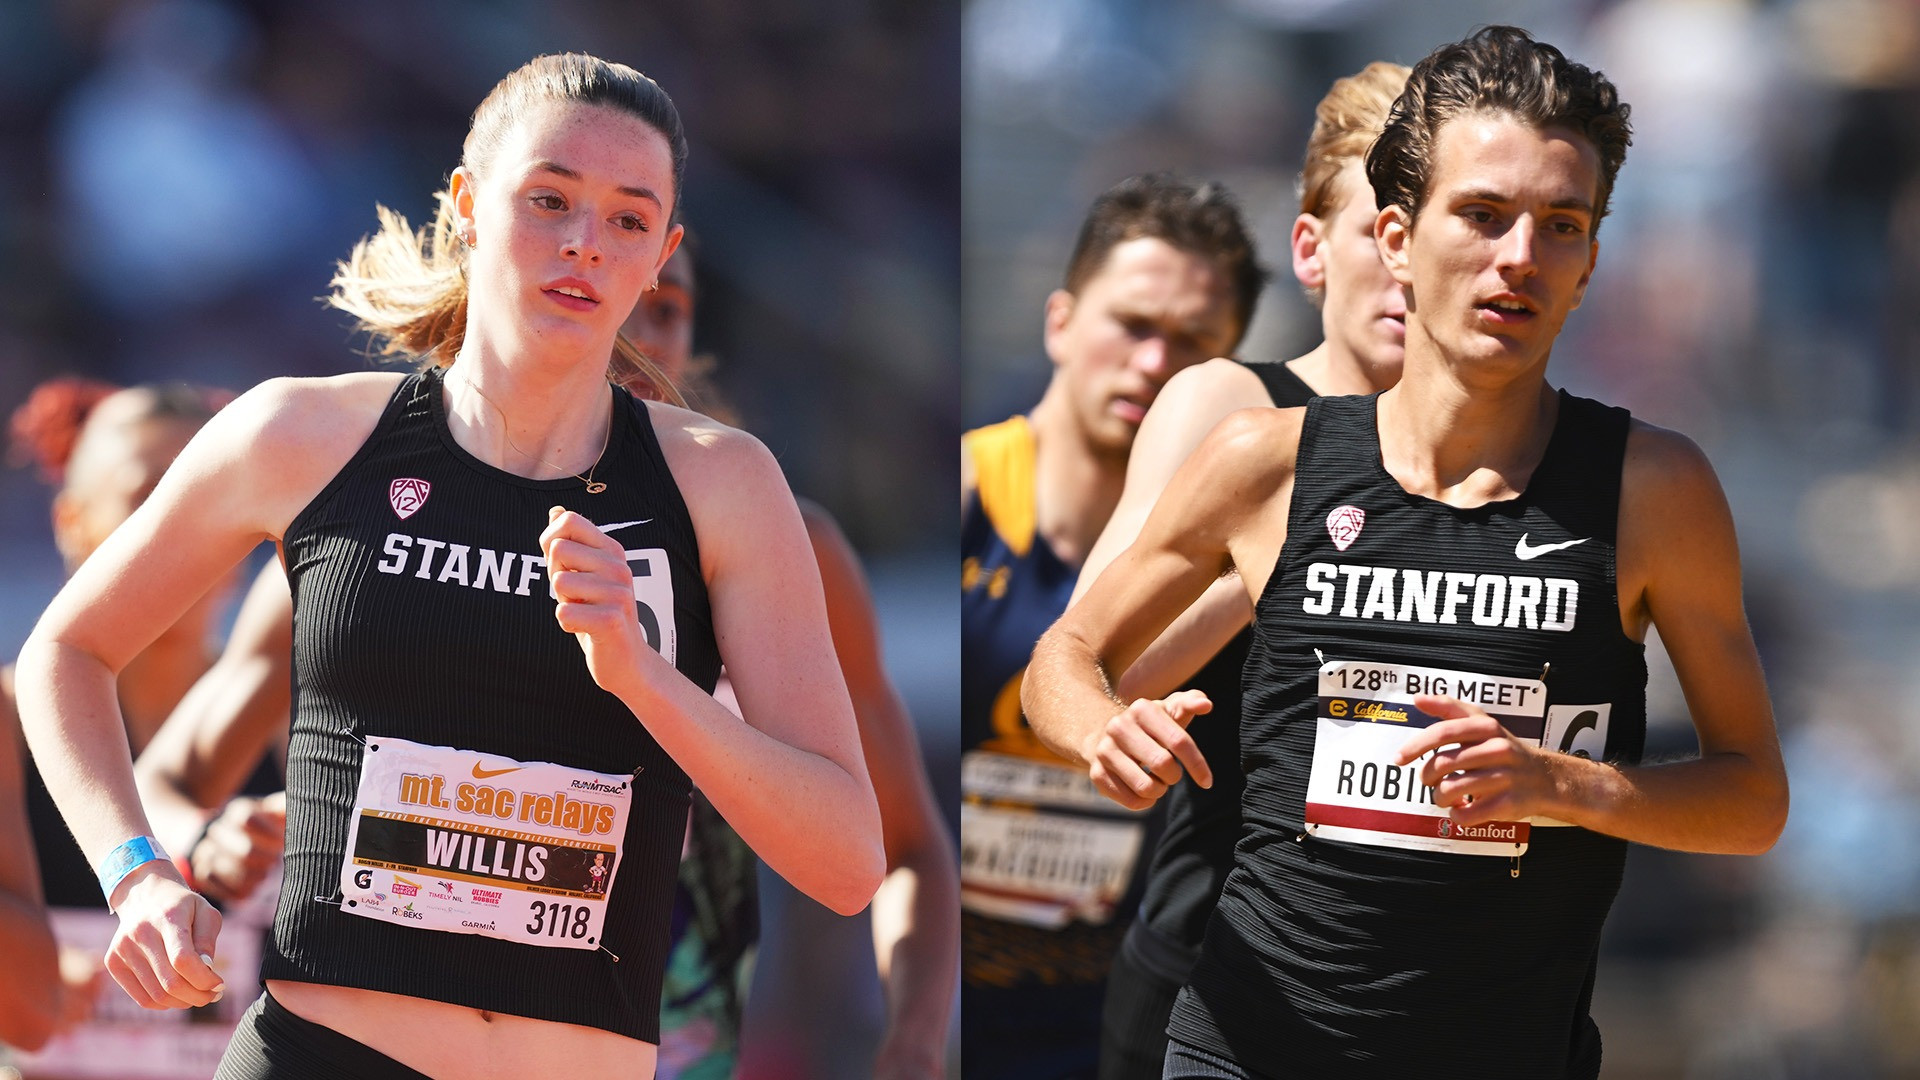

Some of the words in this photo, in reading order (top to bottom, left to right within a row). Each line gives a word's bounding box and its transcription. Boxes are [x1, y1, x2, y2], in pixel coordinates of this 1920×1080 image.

[392, 479, 428, 505] PAC
[396, 496, 417, 512] 12
[1334, 525, 1352, 542] 12
[377, 532, 557, 600] STANF
[1303, 562, 1579, 632] STANFORD
[1337, 668, 1398, 691] 128th
[1406, 673, 1448, 696] BIG
[1458, 679, 1531, 707] MEET
[1353, 701, 1409, 722] California
[1337, 759, 1437, 806] ROBIN
[398, 773, 451, 811] mt.
[456, 781, 516, 818] sac
[518, 791, 616, 836] relays
[378, 811, 408, 822] WHERE
[413, 816, 431, 825] THE
[435, 820, 479, 832] WORLD'S
[483, 826, 507, 837] BEST
[512, 832, 559, 845] ATHLETES
[563, 839, 603, 851] COMPETE
[1455, 823, 1516, 839] Stanford
[426, 828, 549, 883] WILLIS
[354, 869, 373, 889] G
[428, 892, 451, 900] TIMELY
[471, 888, 502, 899] ULTIMATE
[473, 896, 499, 904] HOBBIES
[392, 906, 423, 920] ROBEKS
[526, 900, 591, 939] 3118
[461, 920, 496, 931] GARMIN
